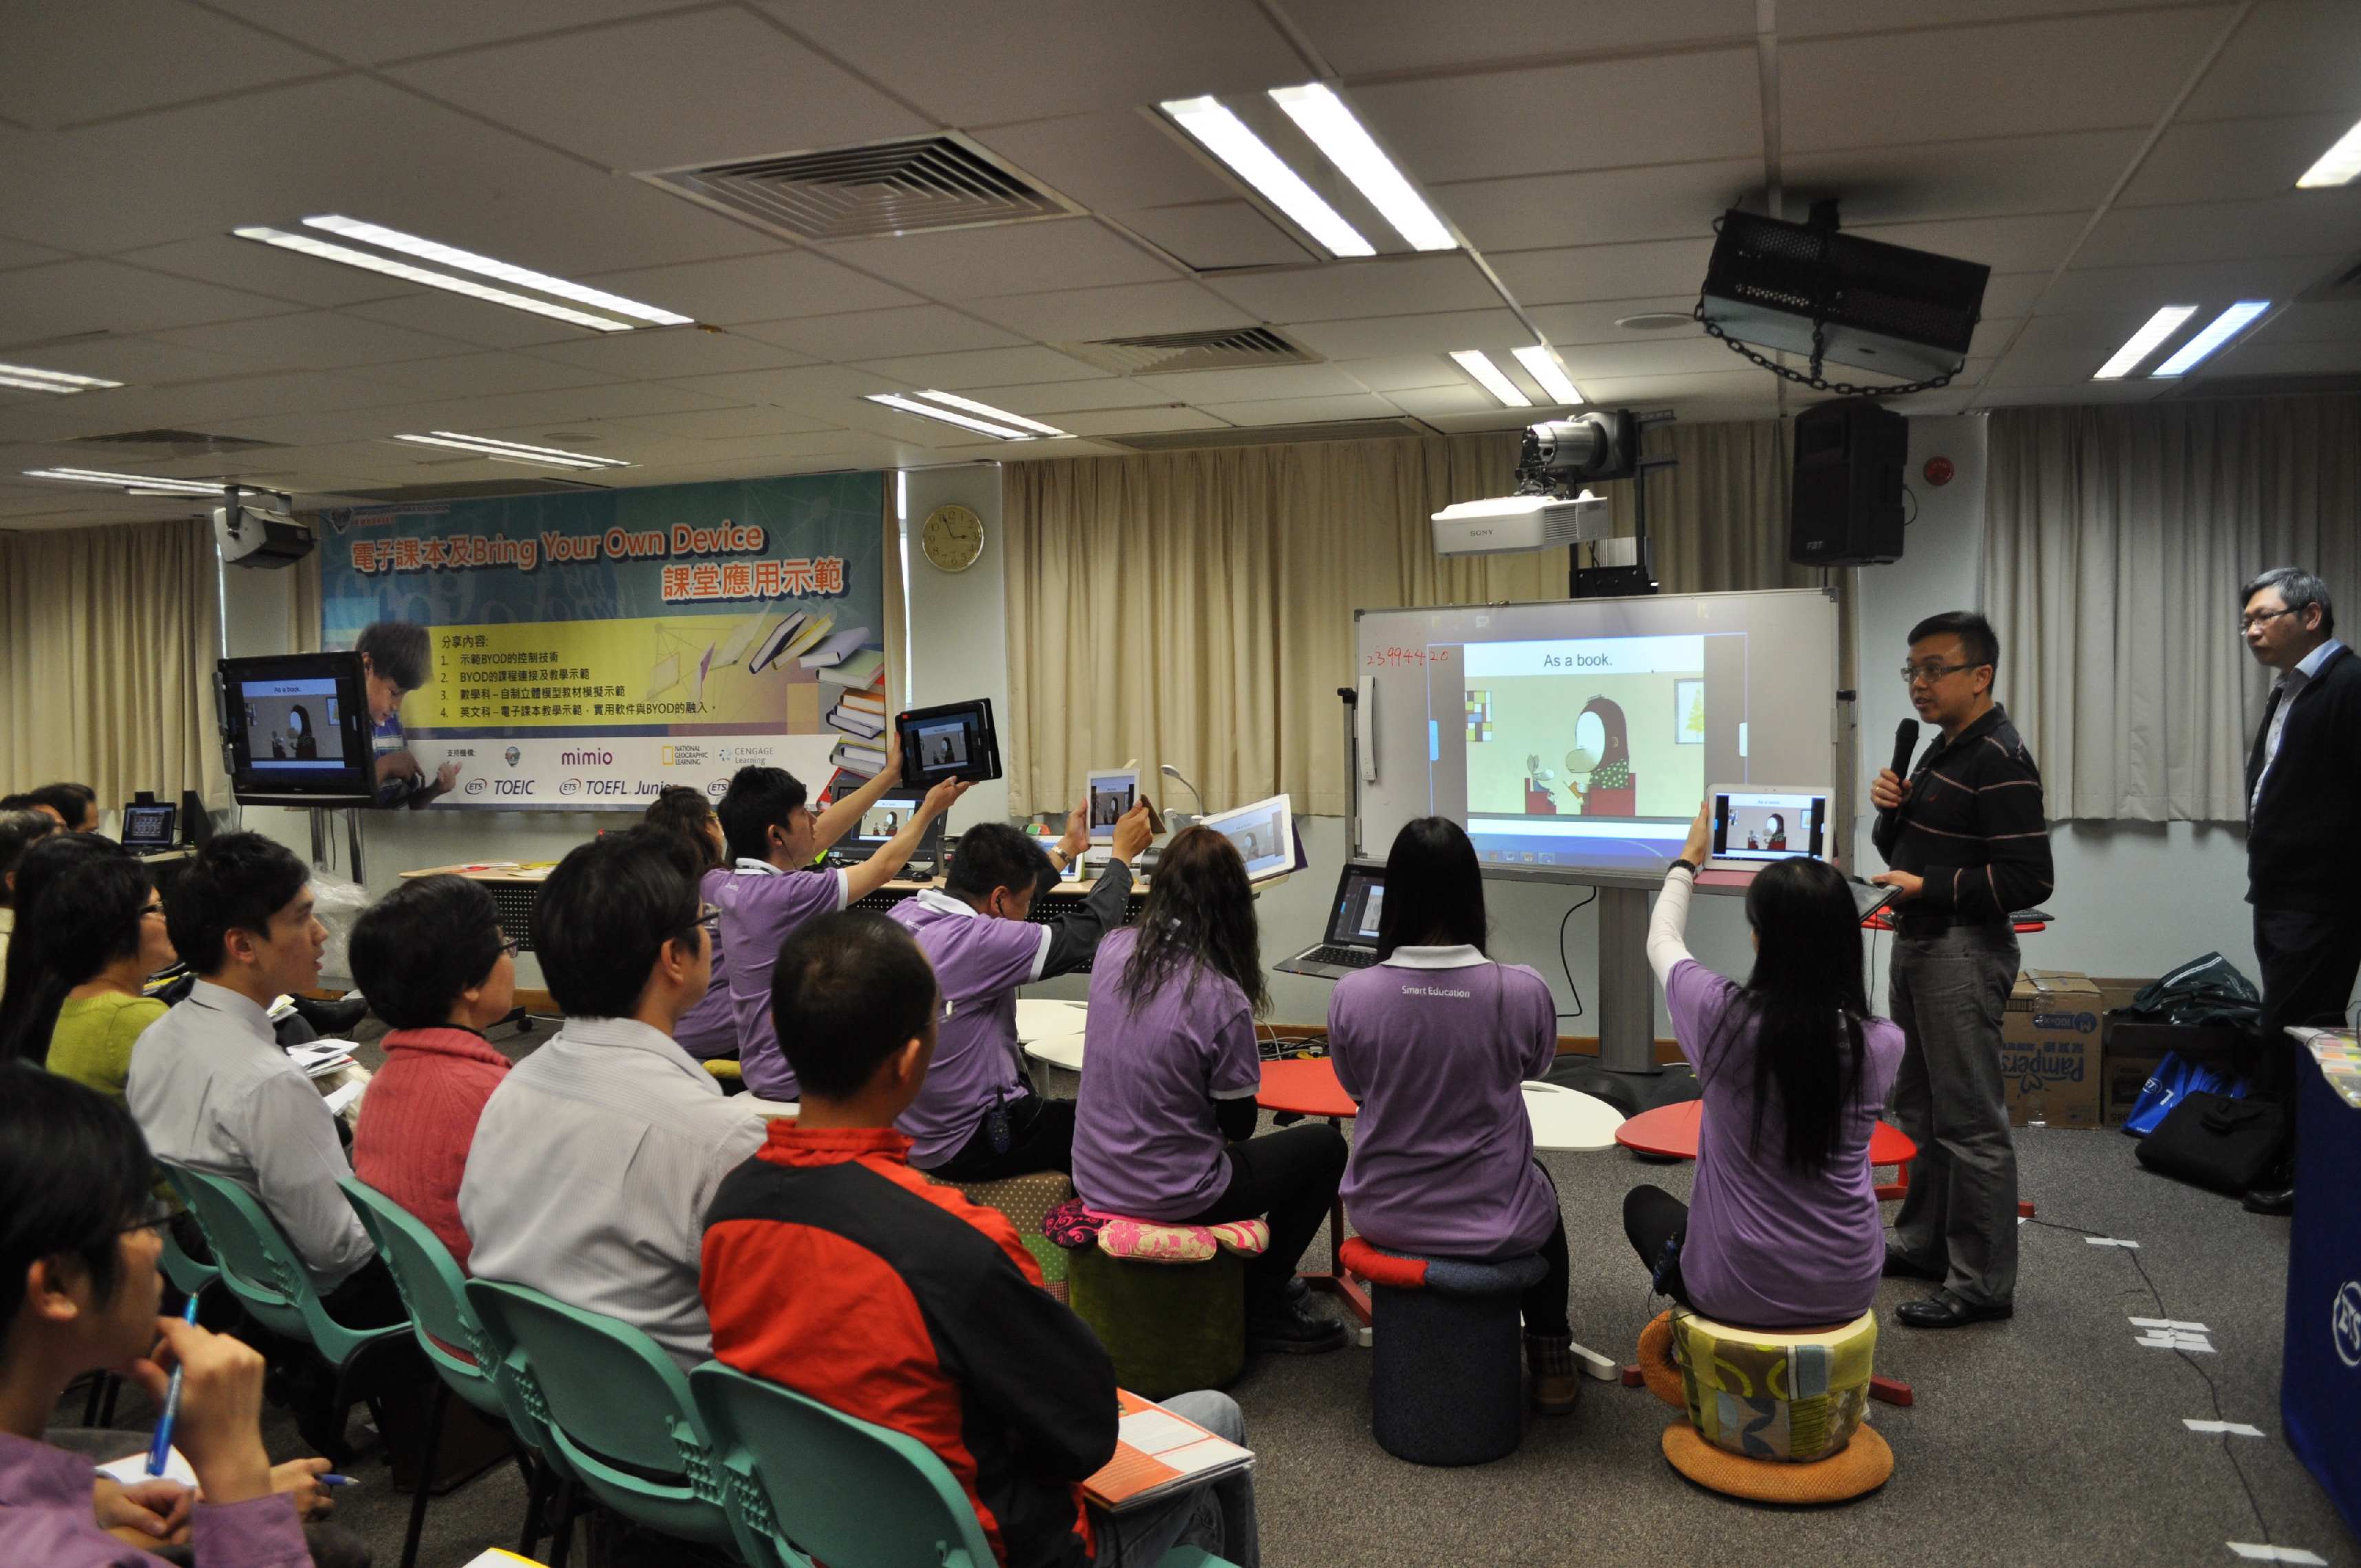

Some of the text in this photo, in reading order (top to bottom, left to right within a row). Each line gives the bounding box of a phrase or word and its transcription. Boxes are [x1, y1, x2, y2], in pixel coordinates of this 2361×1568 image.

[541, 531, 601, 561] Your
[604, 527, 664, 559] Own
[671, 519, 763, 553] Device
[661, 556, 843, 600] 課堂應用示範
[441, 655, 449, 666] 1.
[1543, 653, 1612, 666] As a book.
[441, 672, 449, 682] 2.
[441, 690, 449, 700] 3.
[441, 708, 449, 717] 4.
[562, 748, 613, 765] mimio
[735, 756, 766, 765] Learning
[494, 780, 535, 795] TOEIC
[586, 781, 628, 795] TOEFL
[712, 783, 727, 792] ETS
[1401, 985, 1470, 998] Smart Education
